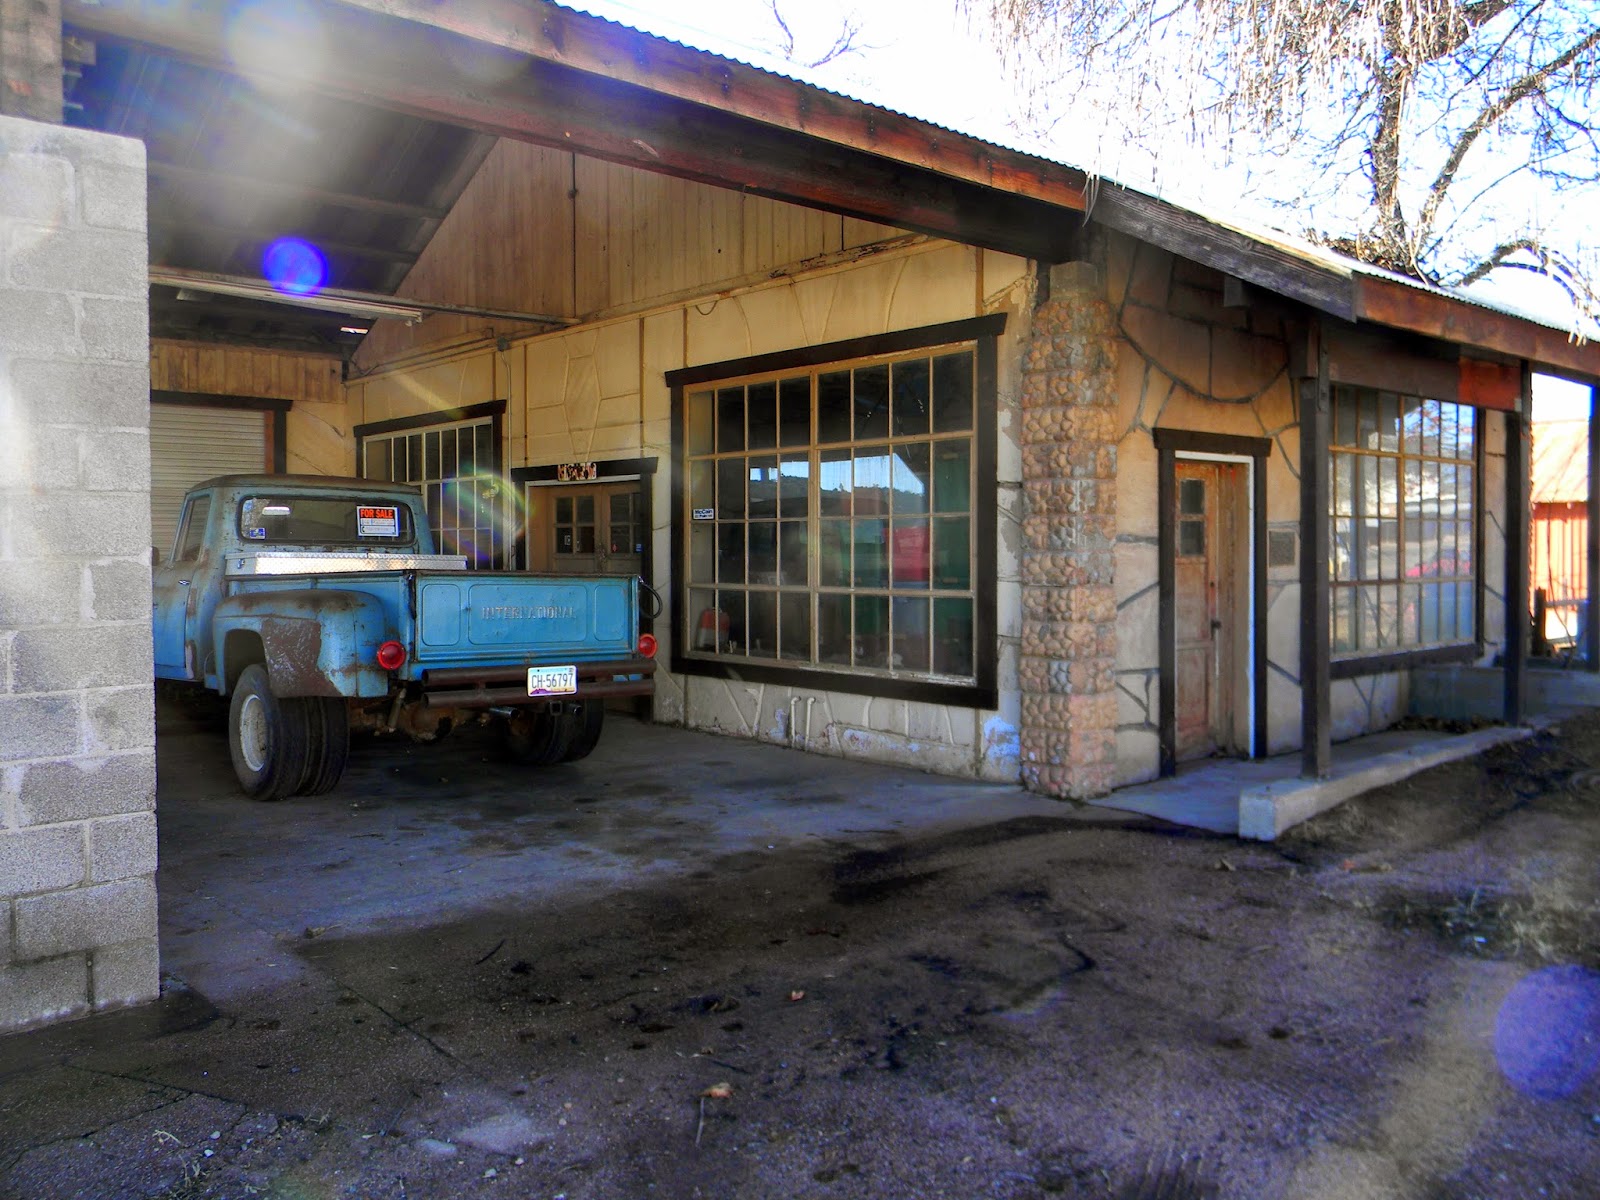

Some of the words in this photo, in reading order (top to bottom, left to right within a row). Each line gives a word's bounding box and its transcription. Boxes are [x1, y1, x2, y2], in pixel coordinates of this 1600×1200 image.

[360, 508, 374, 518] FOR
[375, 509, 393, 519] SALE
[482, 606, 577, 620] INTERNATIONAL
[531, 673, 574, 689] CH-56797
